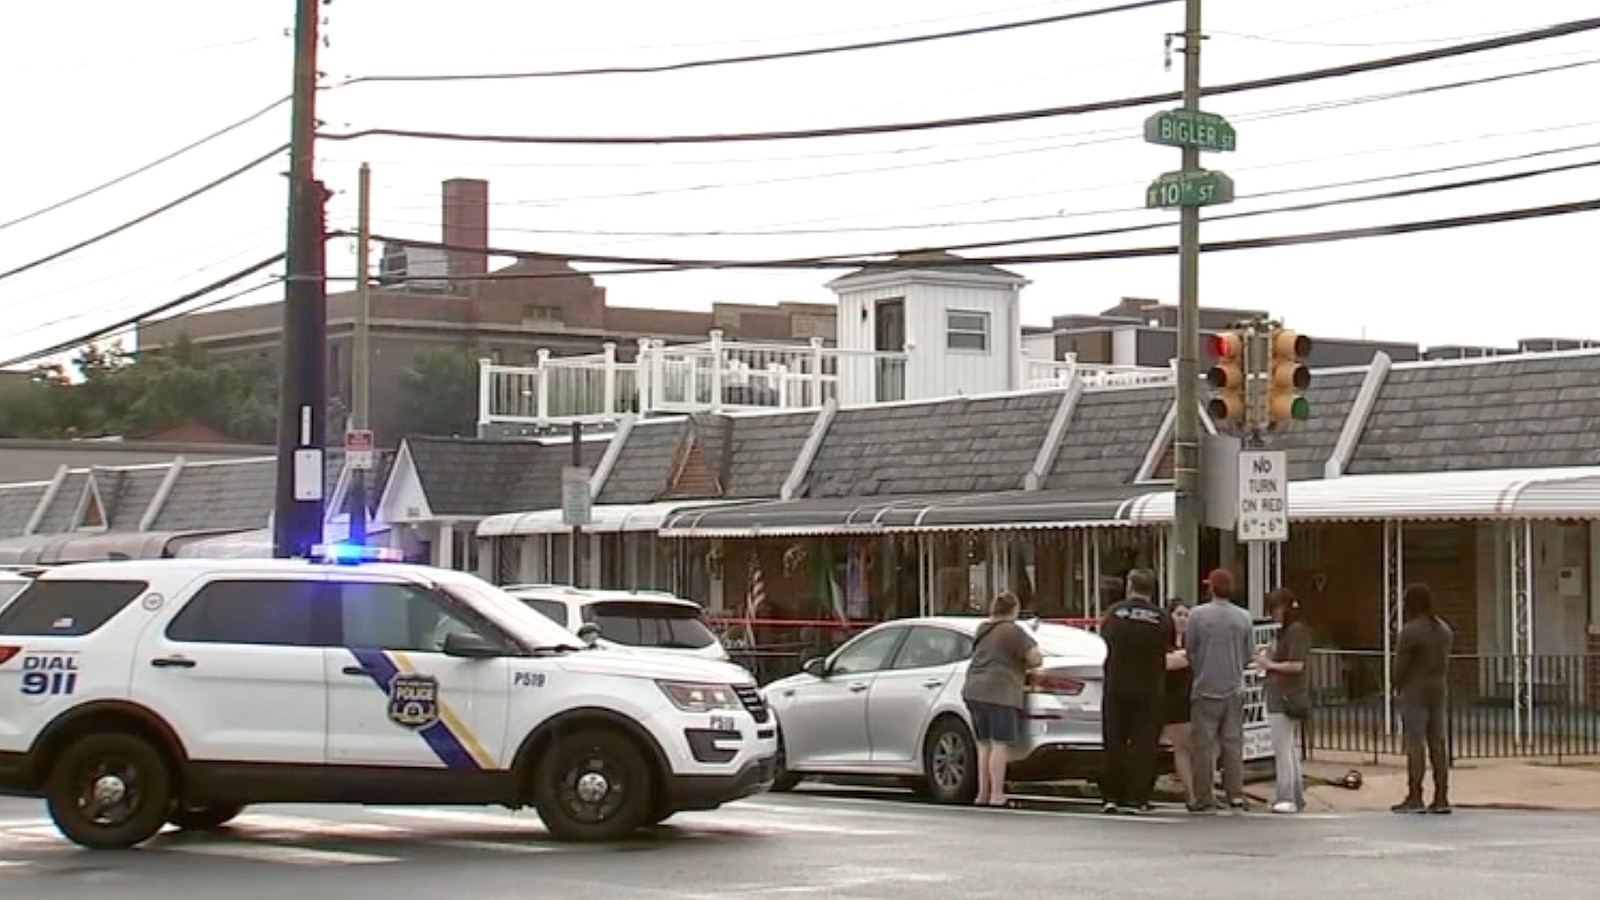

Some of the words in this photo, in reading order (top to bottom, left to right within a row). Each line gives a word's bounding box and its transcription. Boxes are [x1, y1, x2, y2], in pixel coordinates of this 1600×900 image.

[1161, 118, 1217, 145] BIGLER
[1221, 135, 1234, 149] ST
[1199, 184, 1215, 202] ST
[1253, 459, 1272, 473] NO
[1249, 479, 1277, 493] TURN
[1242, 499, 1257, 512] ON
[1262, 498, 1283, 512] RED
[23, 656, 79, 670] DIAL
[20, 672, 77, 695] 911
[396, 686, 433, 700] POLICE
